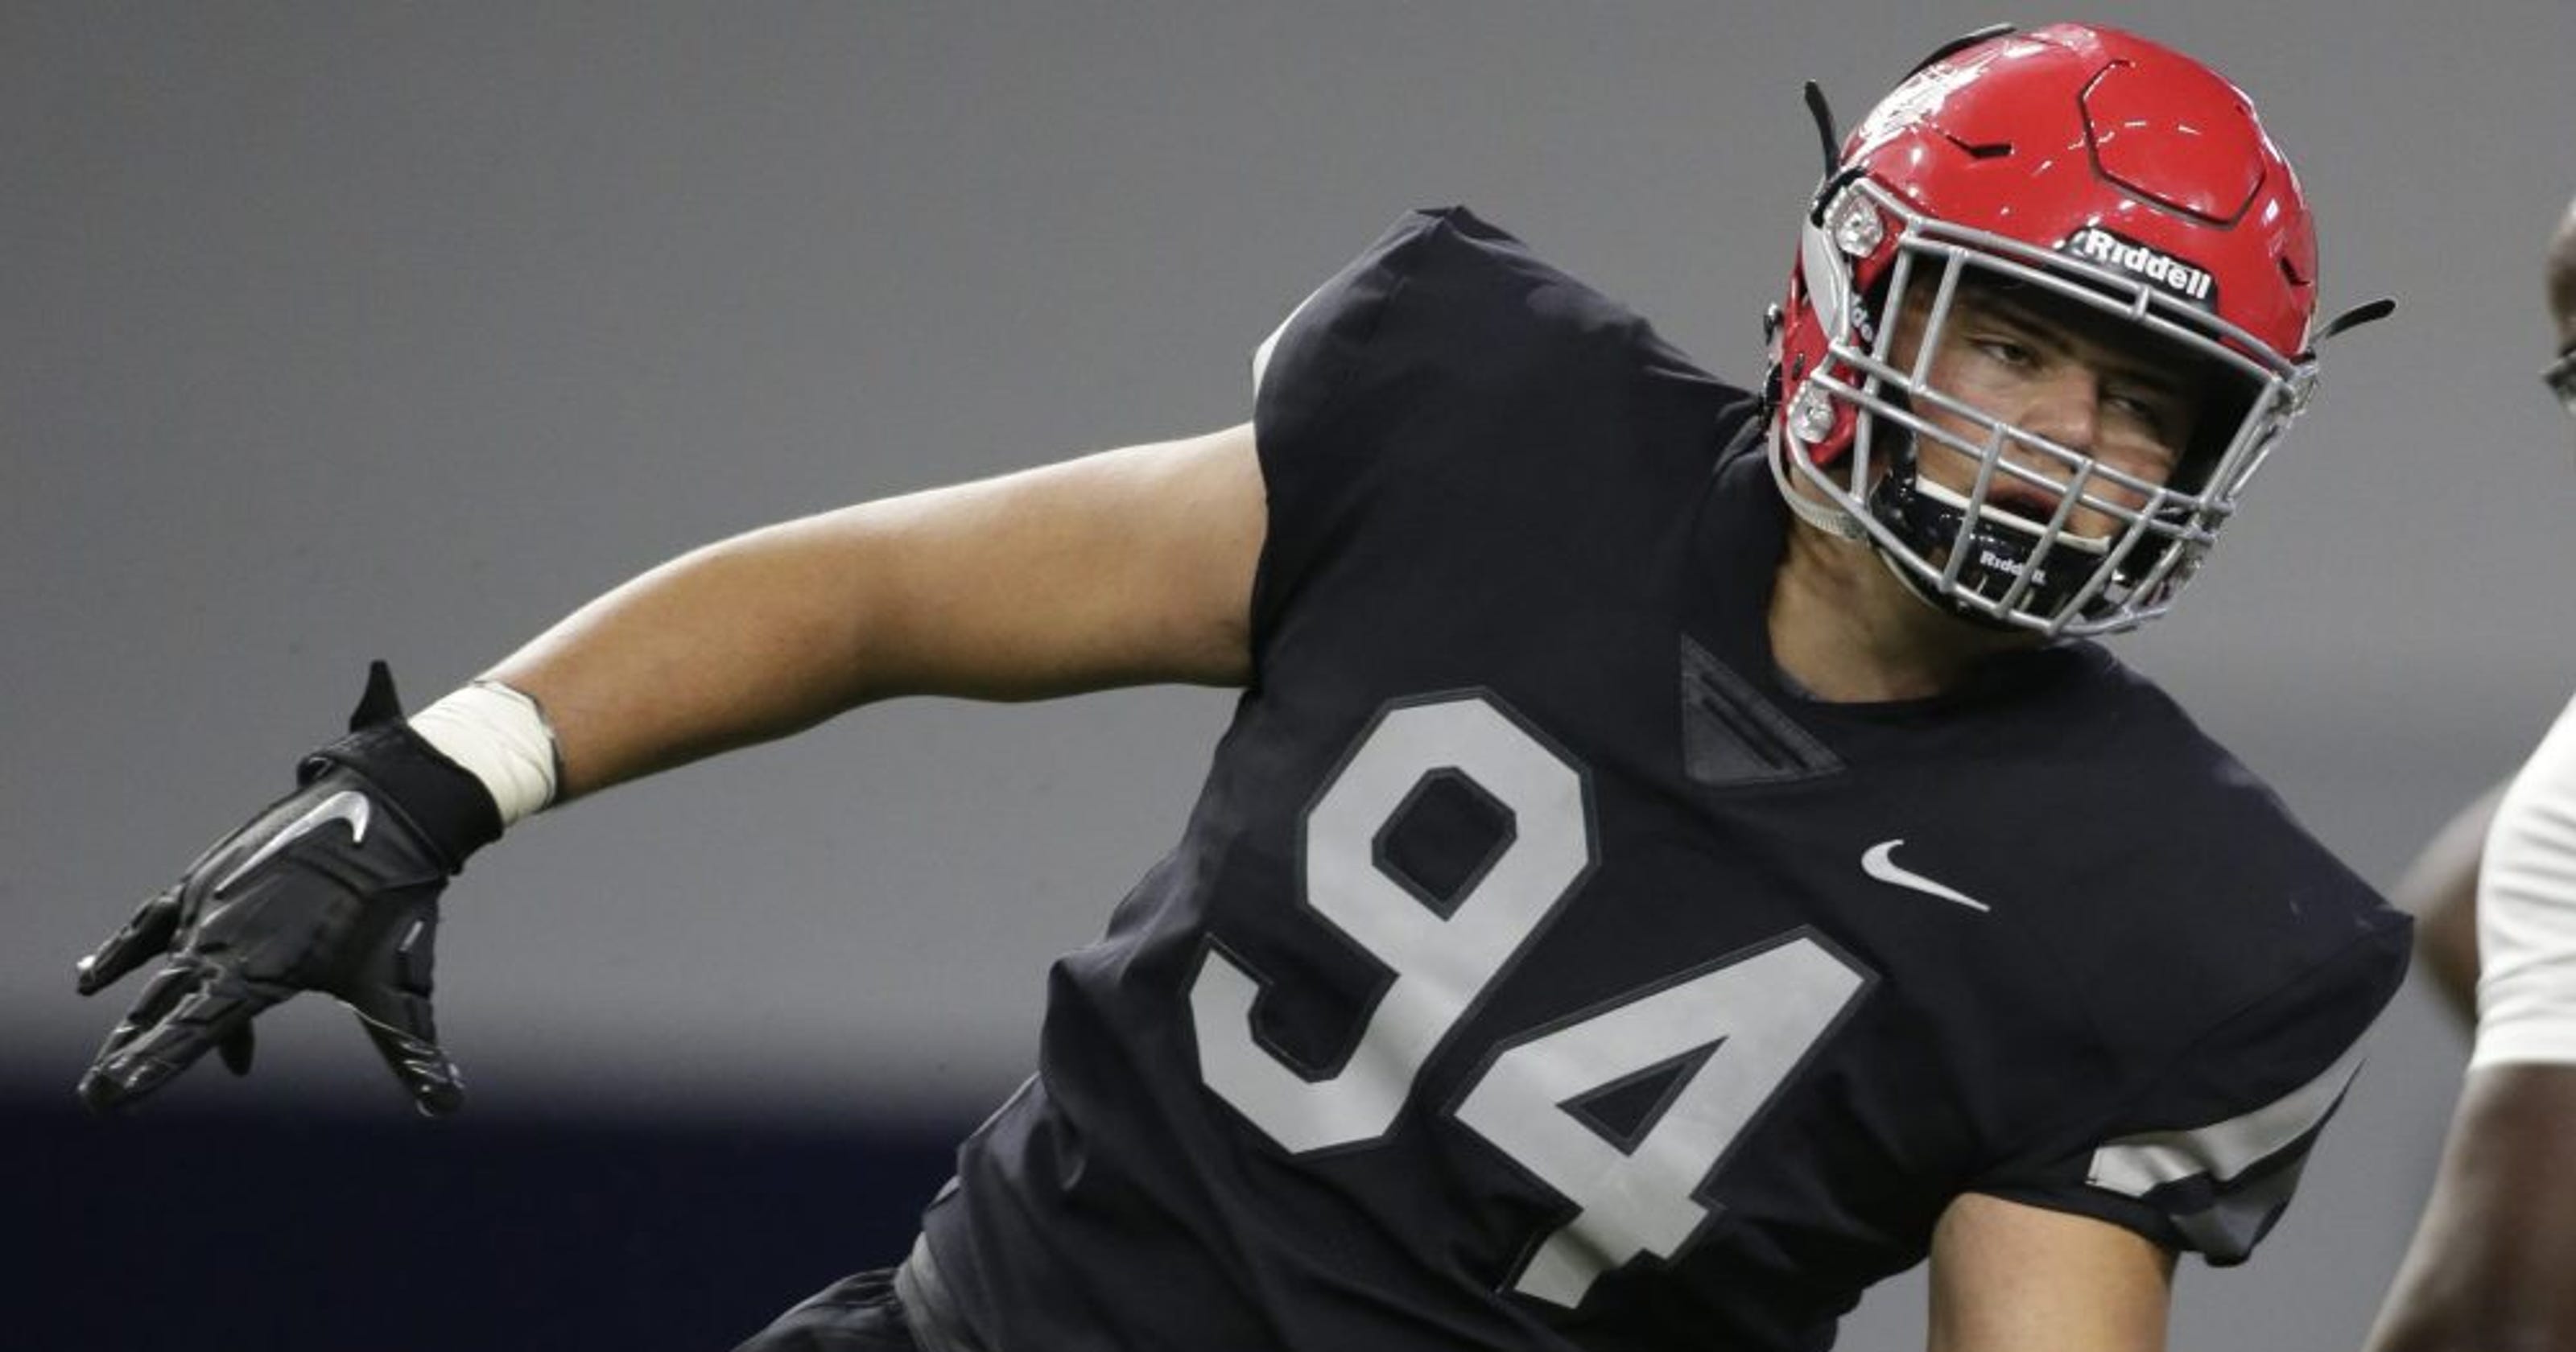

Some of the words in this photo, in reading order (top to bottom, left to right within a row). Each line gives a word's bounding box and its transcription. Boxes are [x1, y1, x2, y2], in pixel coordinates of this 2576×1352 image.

[2083, 228, 2211, 299] Riddell
[1979, 550, 2047, 586] Riddll
[1188, 692, 1869, 1312] 94
